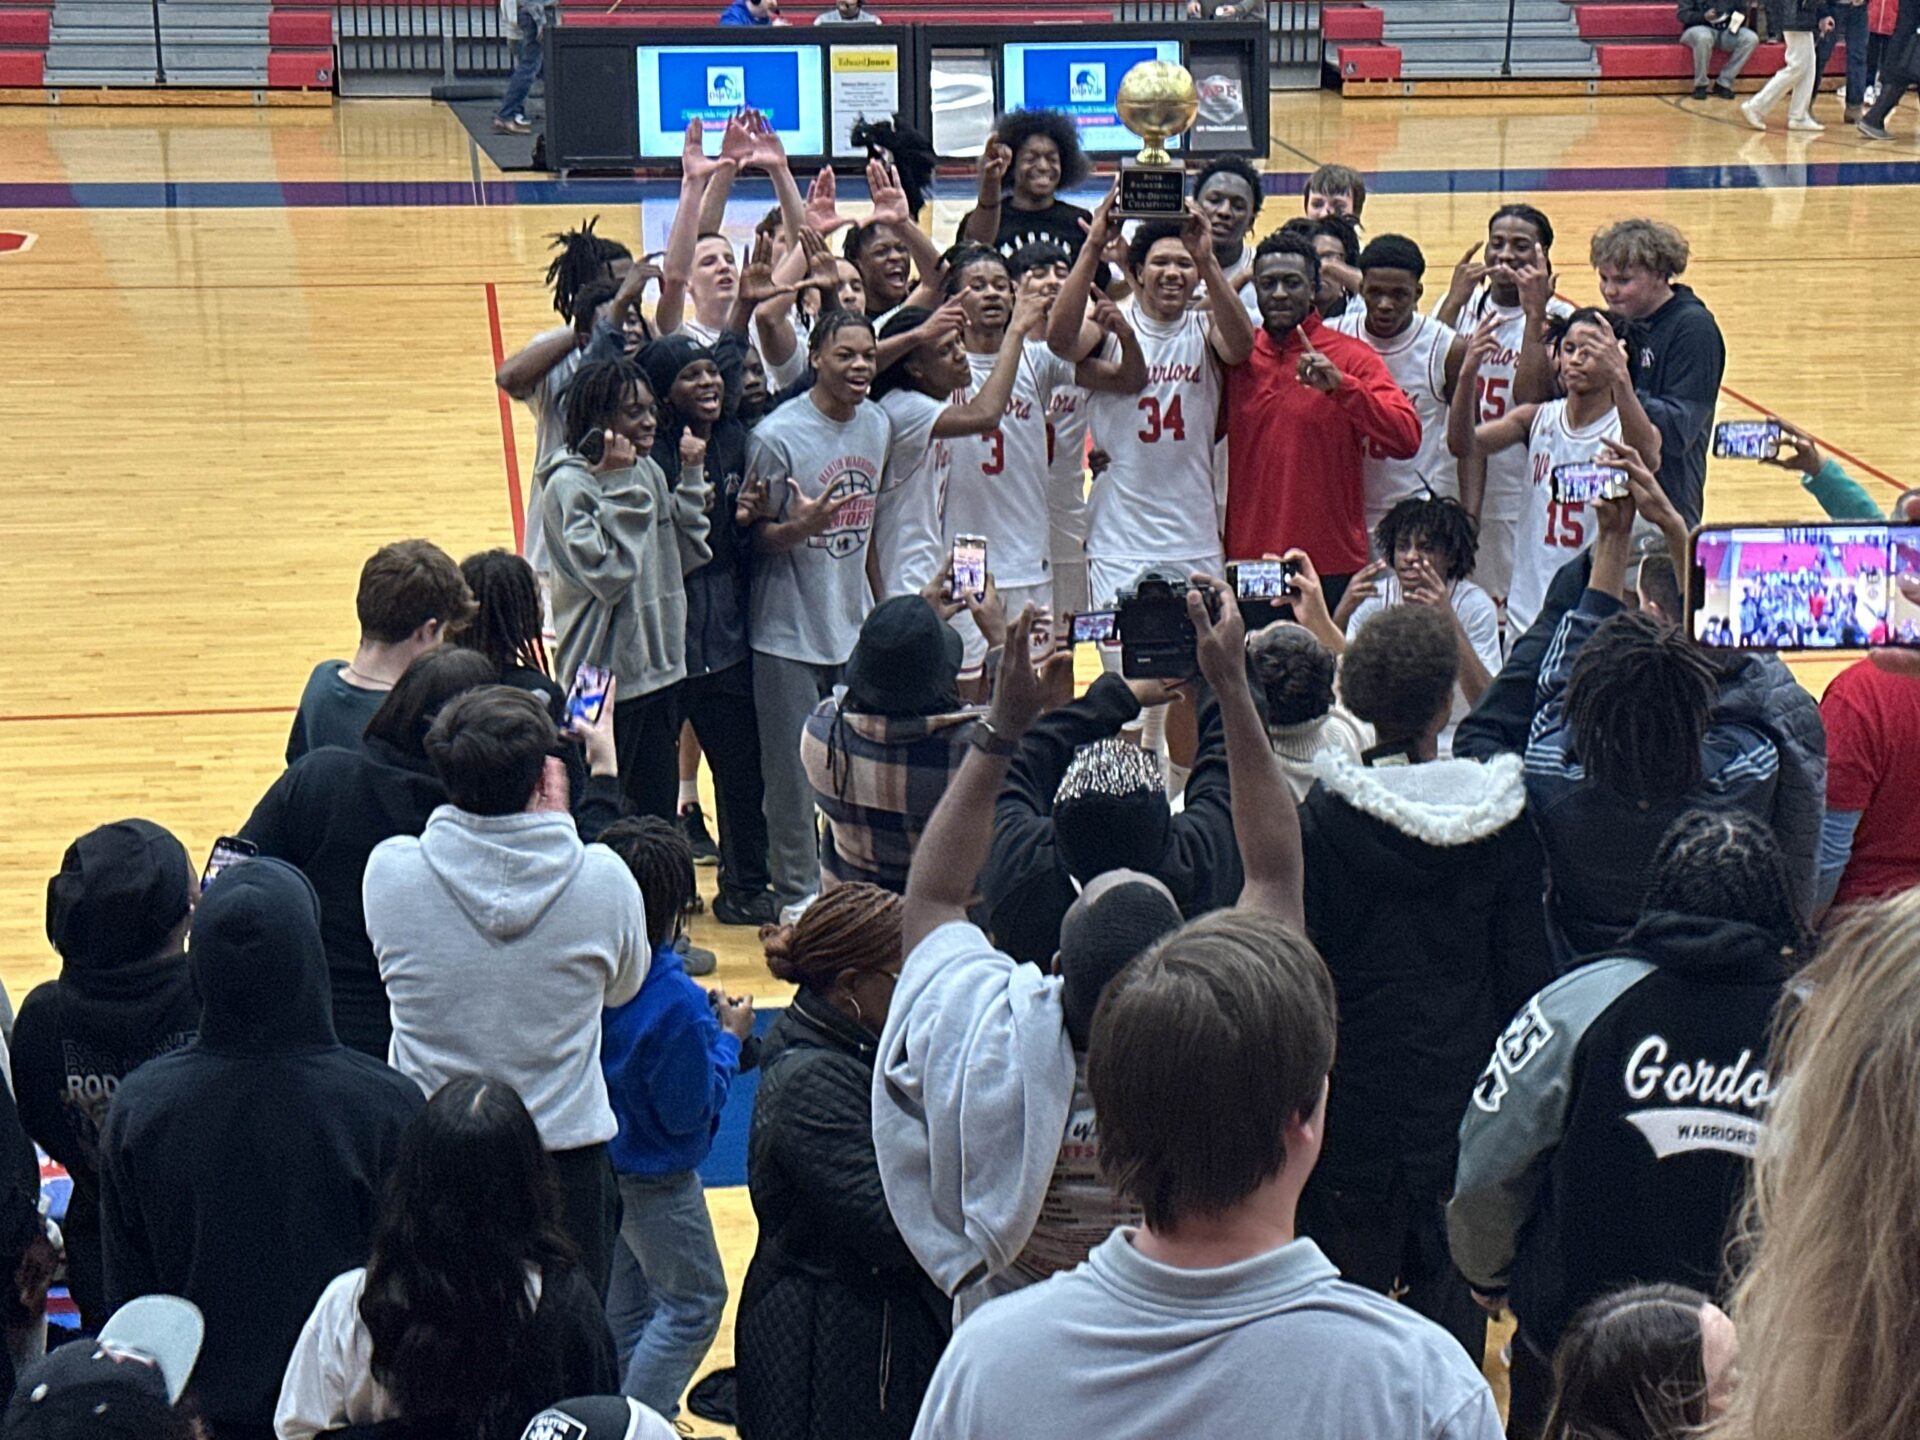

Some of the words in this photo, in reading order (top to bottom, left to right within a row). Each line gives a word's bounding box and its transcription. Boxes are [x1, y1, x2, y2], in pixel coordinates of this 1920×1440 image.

[1138, 394, 1185, 443] 34
[1544, 500, 1585, 549] 15
[1625, 1034, 1780, 1107] Gordo
[1678, 1124, 1758, 1146] WARRIORS
